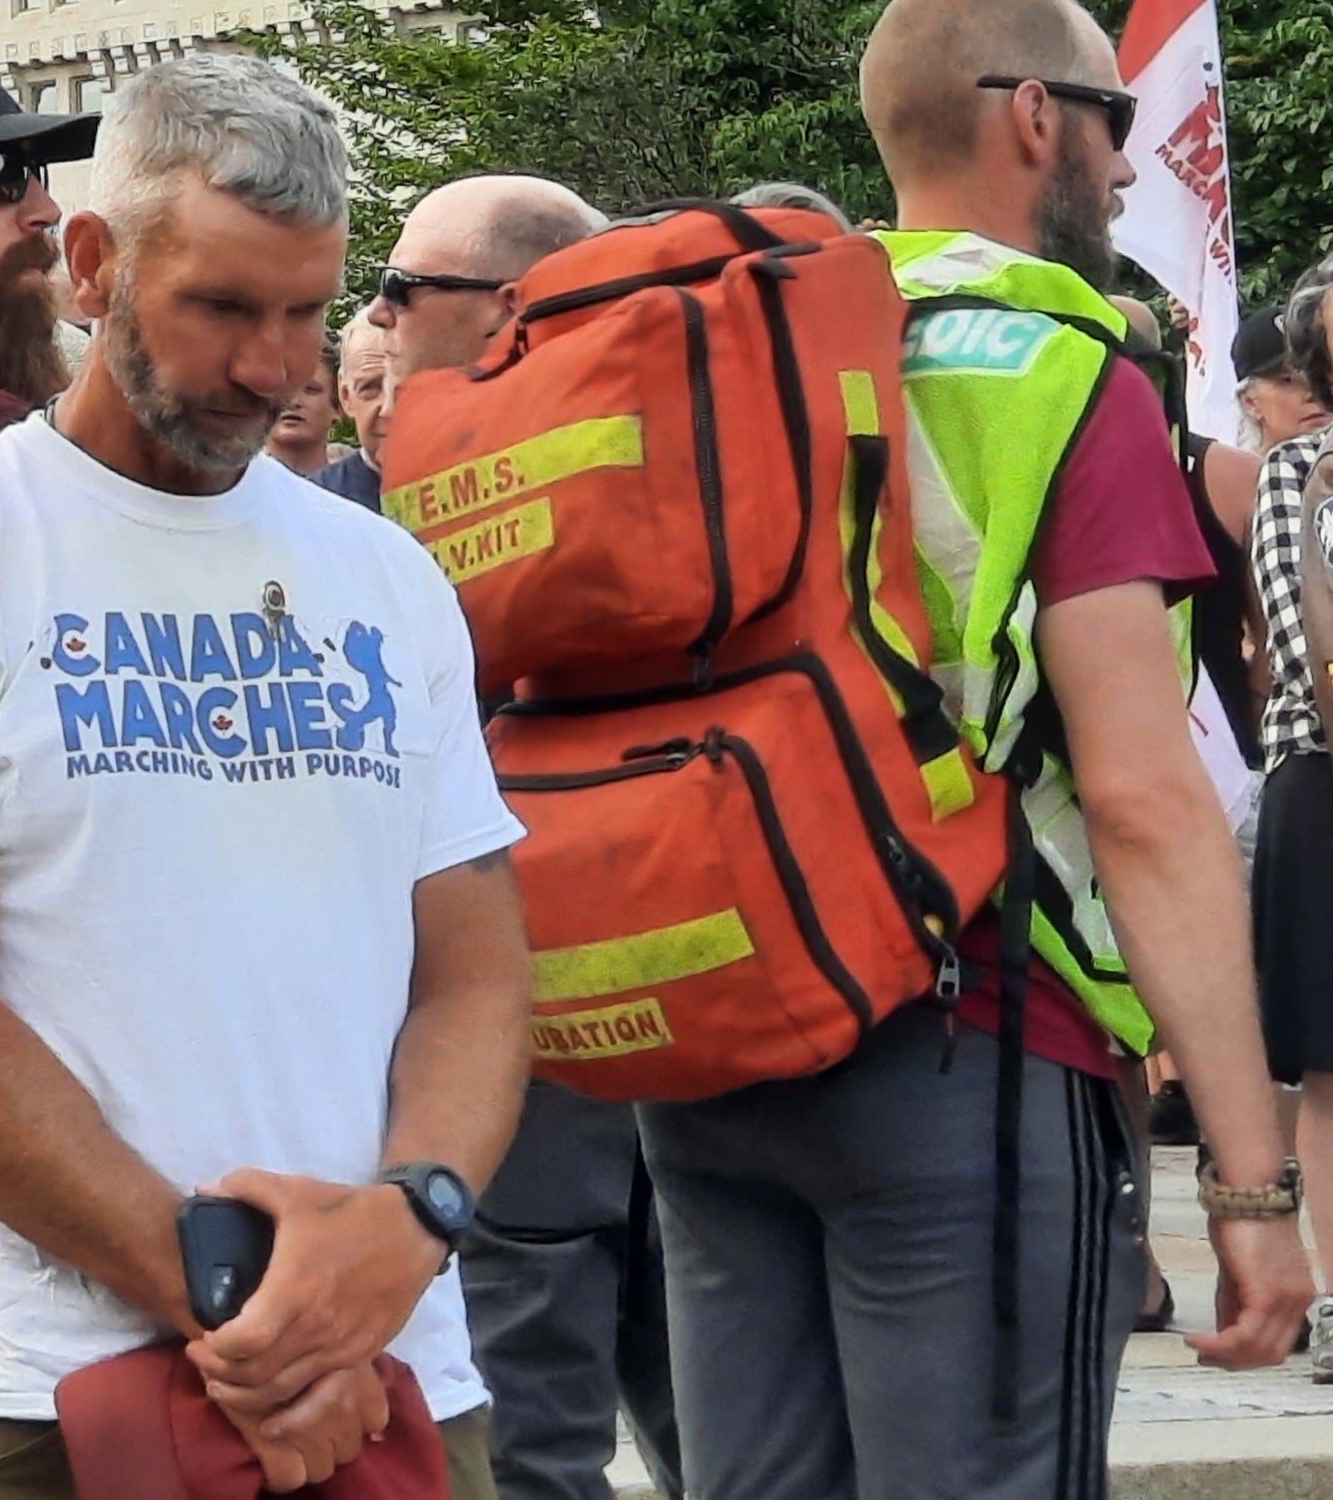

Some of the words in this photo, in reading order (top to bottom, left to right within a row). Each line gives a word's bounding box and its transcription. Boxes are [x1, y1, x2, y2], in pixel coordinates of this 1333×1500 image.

[419, 456, 525, 522] E.M.S.
[52, 611, 324, 684] CANADA
[54, 679, 367, 759] MARCHES
[66, 750, 213, 781] MARCHING
[221, 756, 297, 784] WITH
[307, 752, 402, 789] PURPOSE
